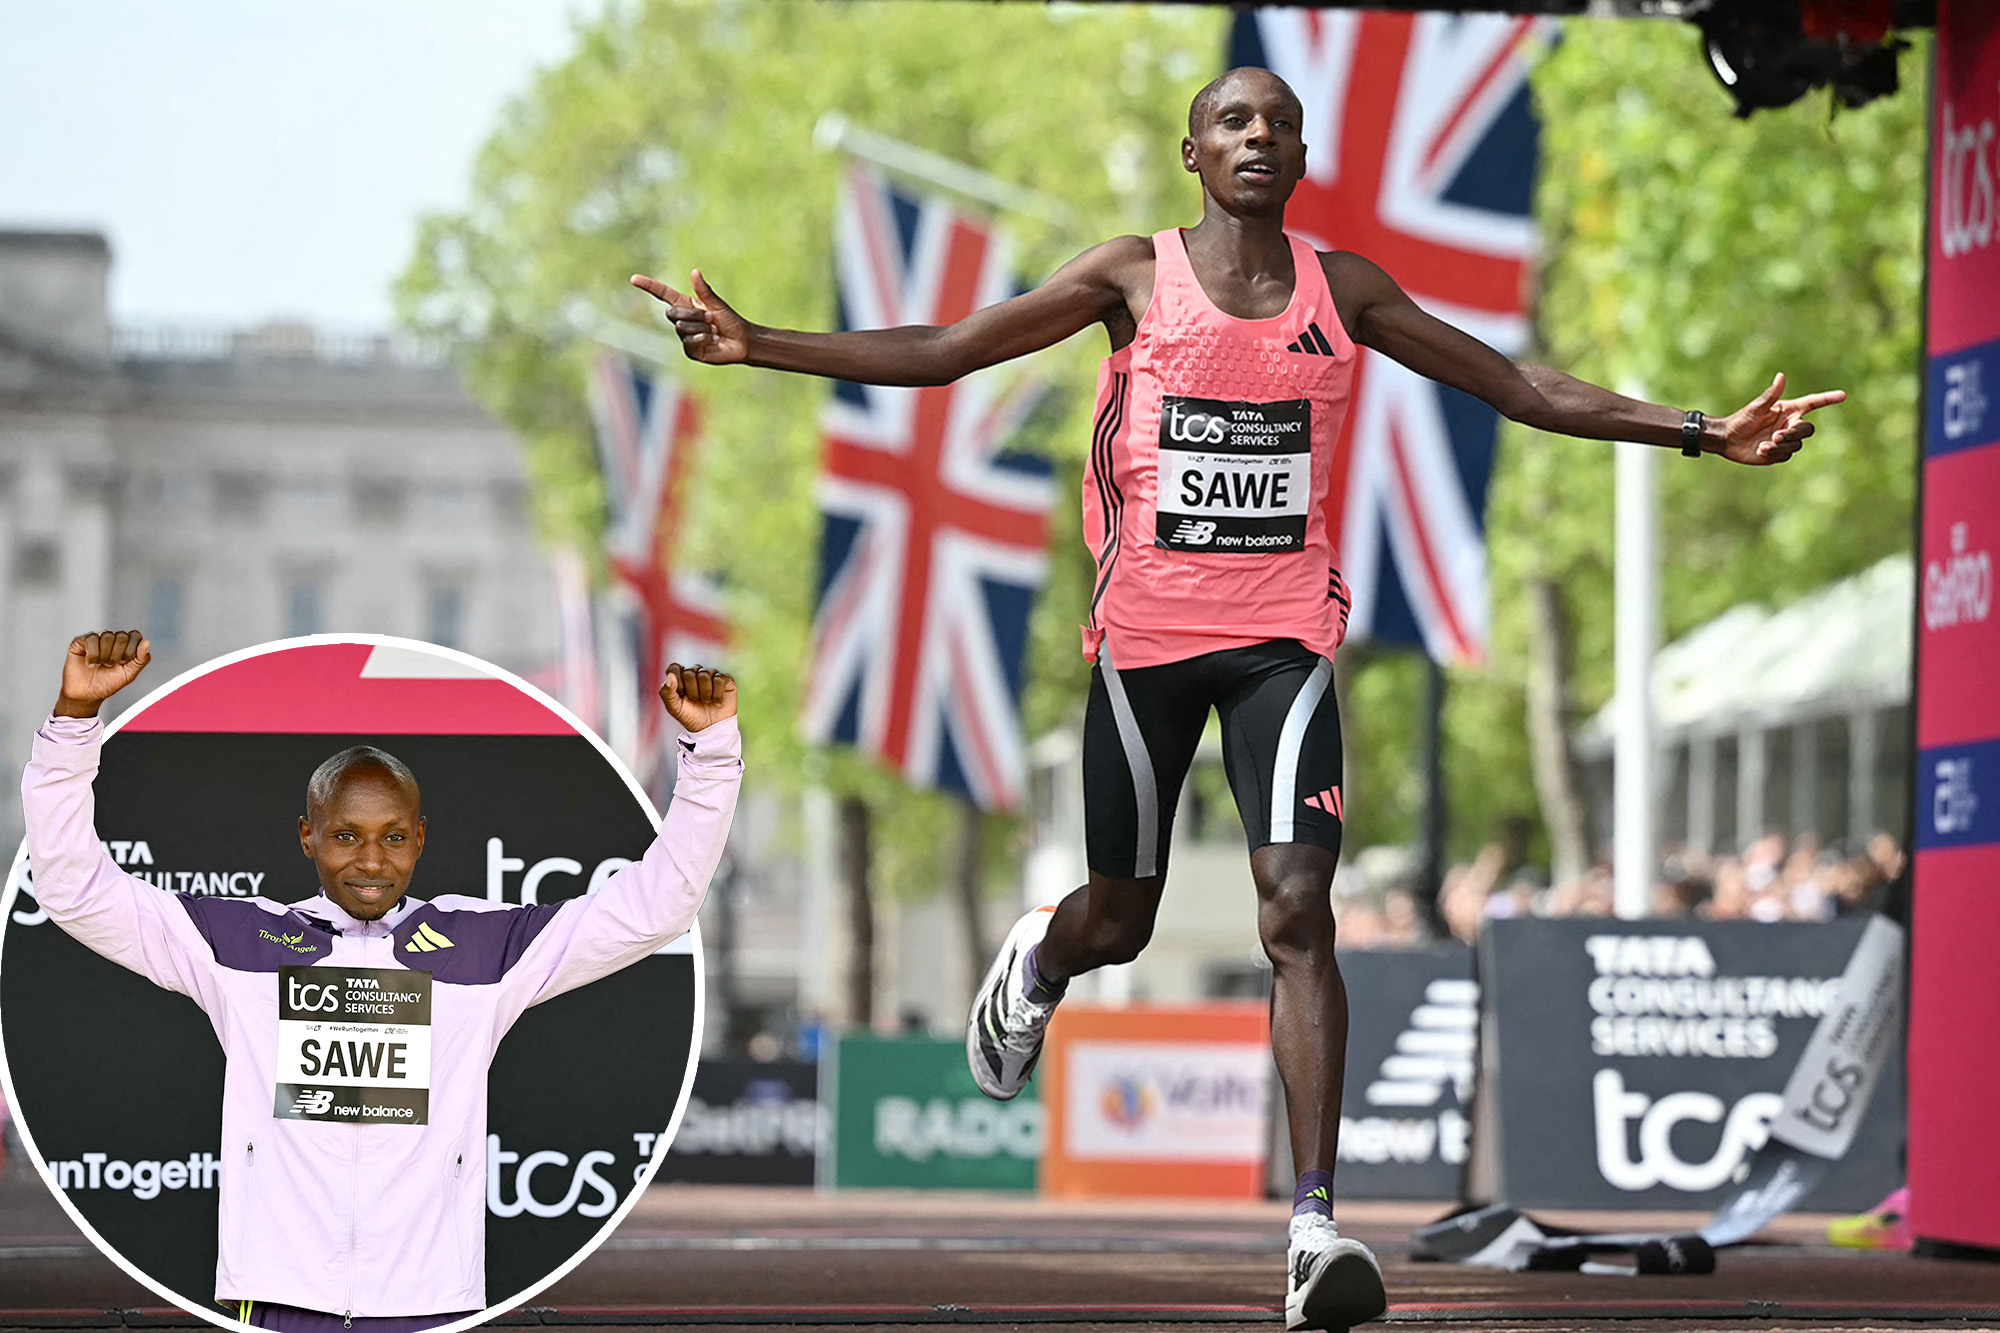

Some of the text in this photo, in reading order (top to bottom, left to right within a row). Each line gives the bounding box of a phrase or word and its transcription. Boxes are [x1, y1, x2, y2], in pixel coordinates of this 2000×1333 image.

[1940, 103, 1994, 258] tcs
[1170, 405, 1225, 444] tcs
[1232, 411, 1264, 421] TATA
[1231, 422, 1302, 434] CONSULTANCY
[1231, 435, 1280, 447] SERVICES
[1181, 469, 1290, 509] SAWE
[1216, 534, 1293, 547] new balance
[100, 841, 154, 865] TA
[1585, 936, 1716, 977] TATA
[345, 978, 380, 989] TATA
[288, 975, 339, 1013] tcs
[345, 990, 422, 1003] CONSULTANCY
[345, 1003, 395, 1015] SERVICES
[329, 1026, 379, 1034] #WeRunTogether
[1591, 1017, 1778, 1058] SERVICES
[300, 1039, 407, 1079] SAWE
[334, 1104, 414, 1118] new balance
[487, 1133, 618, 1218] tcs
